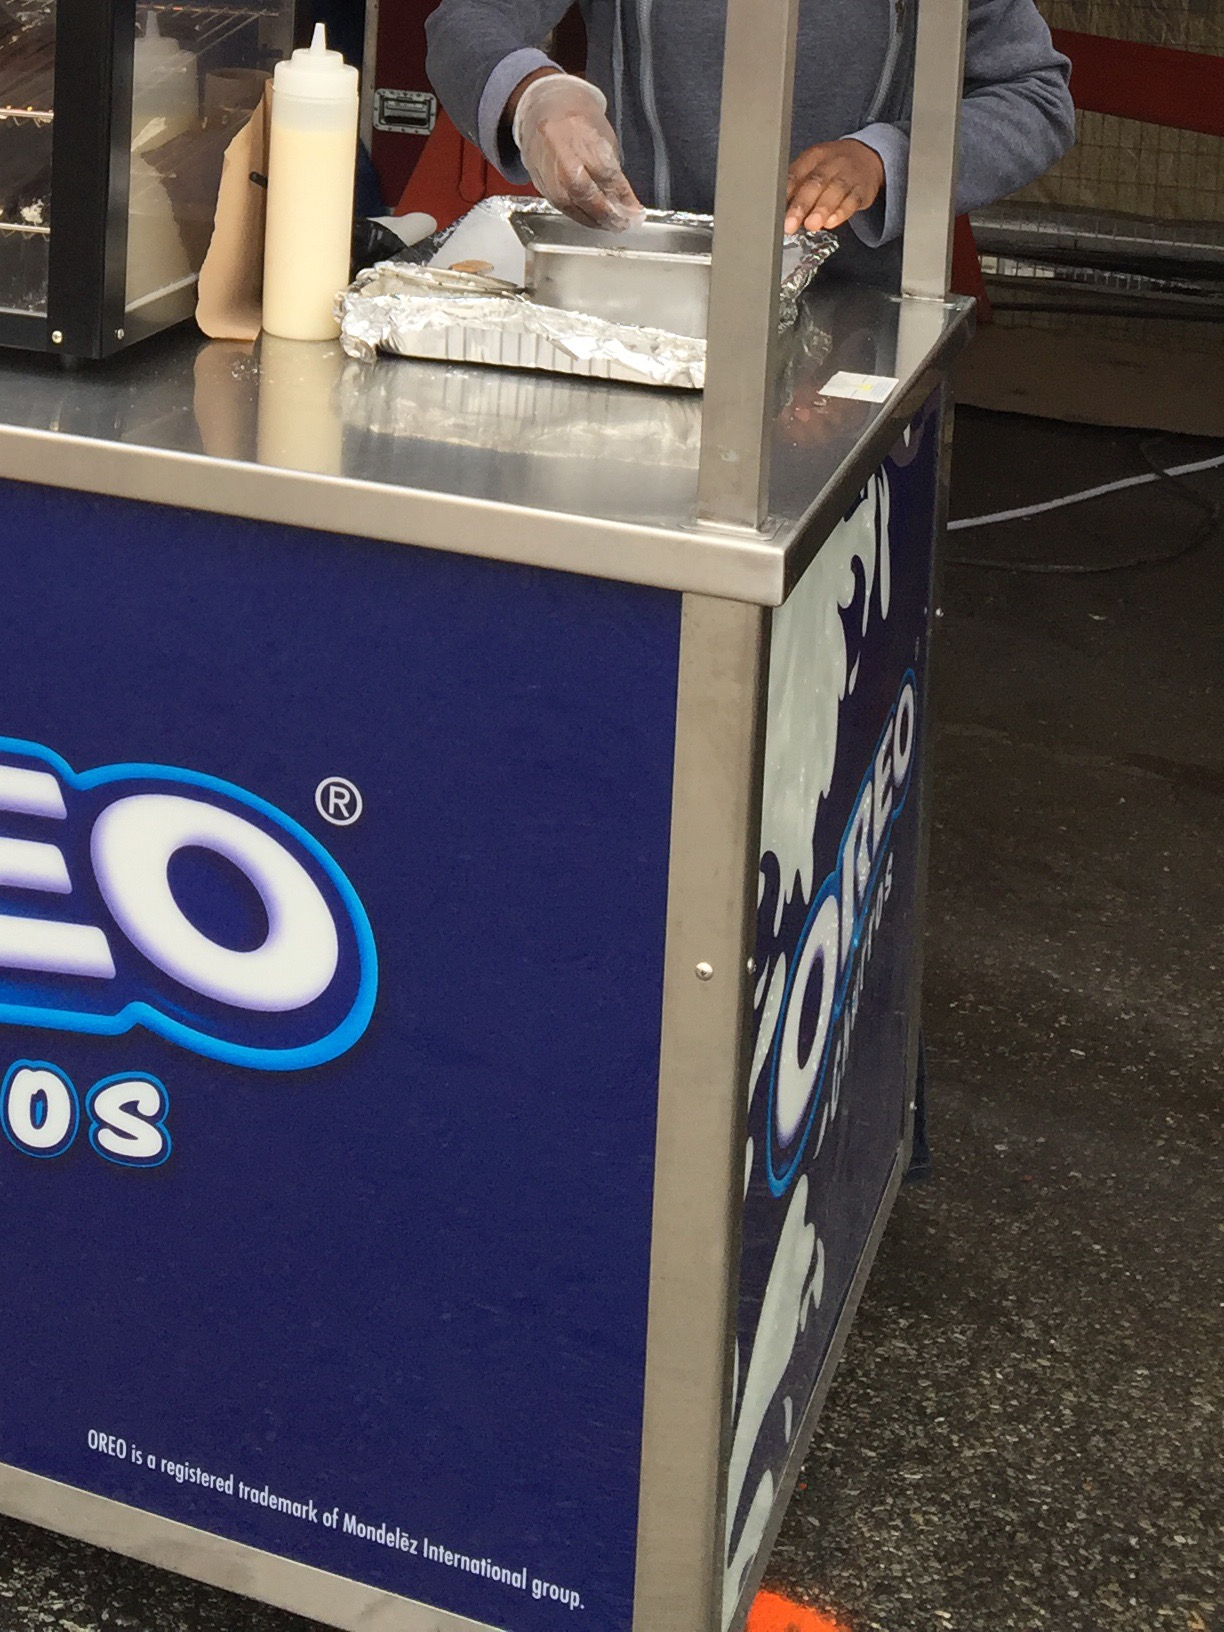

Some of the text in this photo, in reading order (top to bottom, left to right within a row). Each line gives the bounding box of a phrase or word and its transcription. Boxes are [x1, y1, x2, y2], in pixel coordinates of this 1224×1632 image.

[776, 683, 915, 1149] OREO
[87, 1429, 585, 1610] OREO is a registered trademark of Mondelēz International group.
